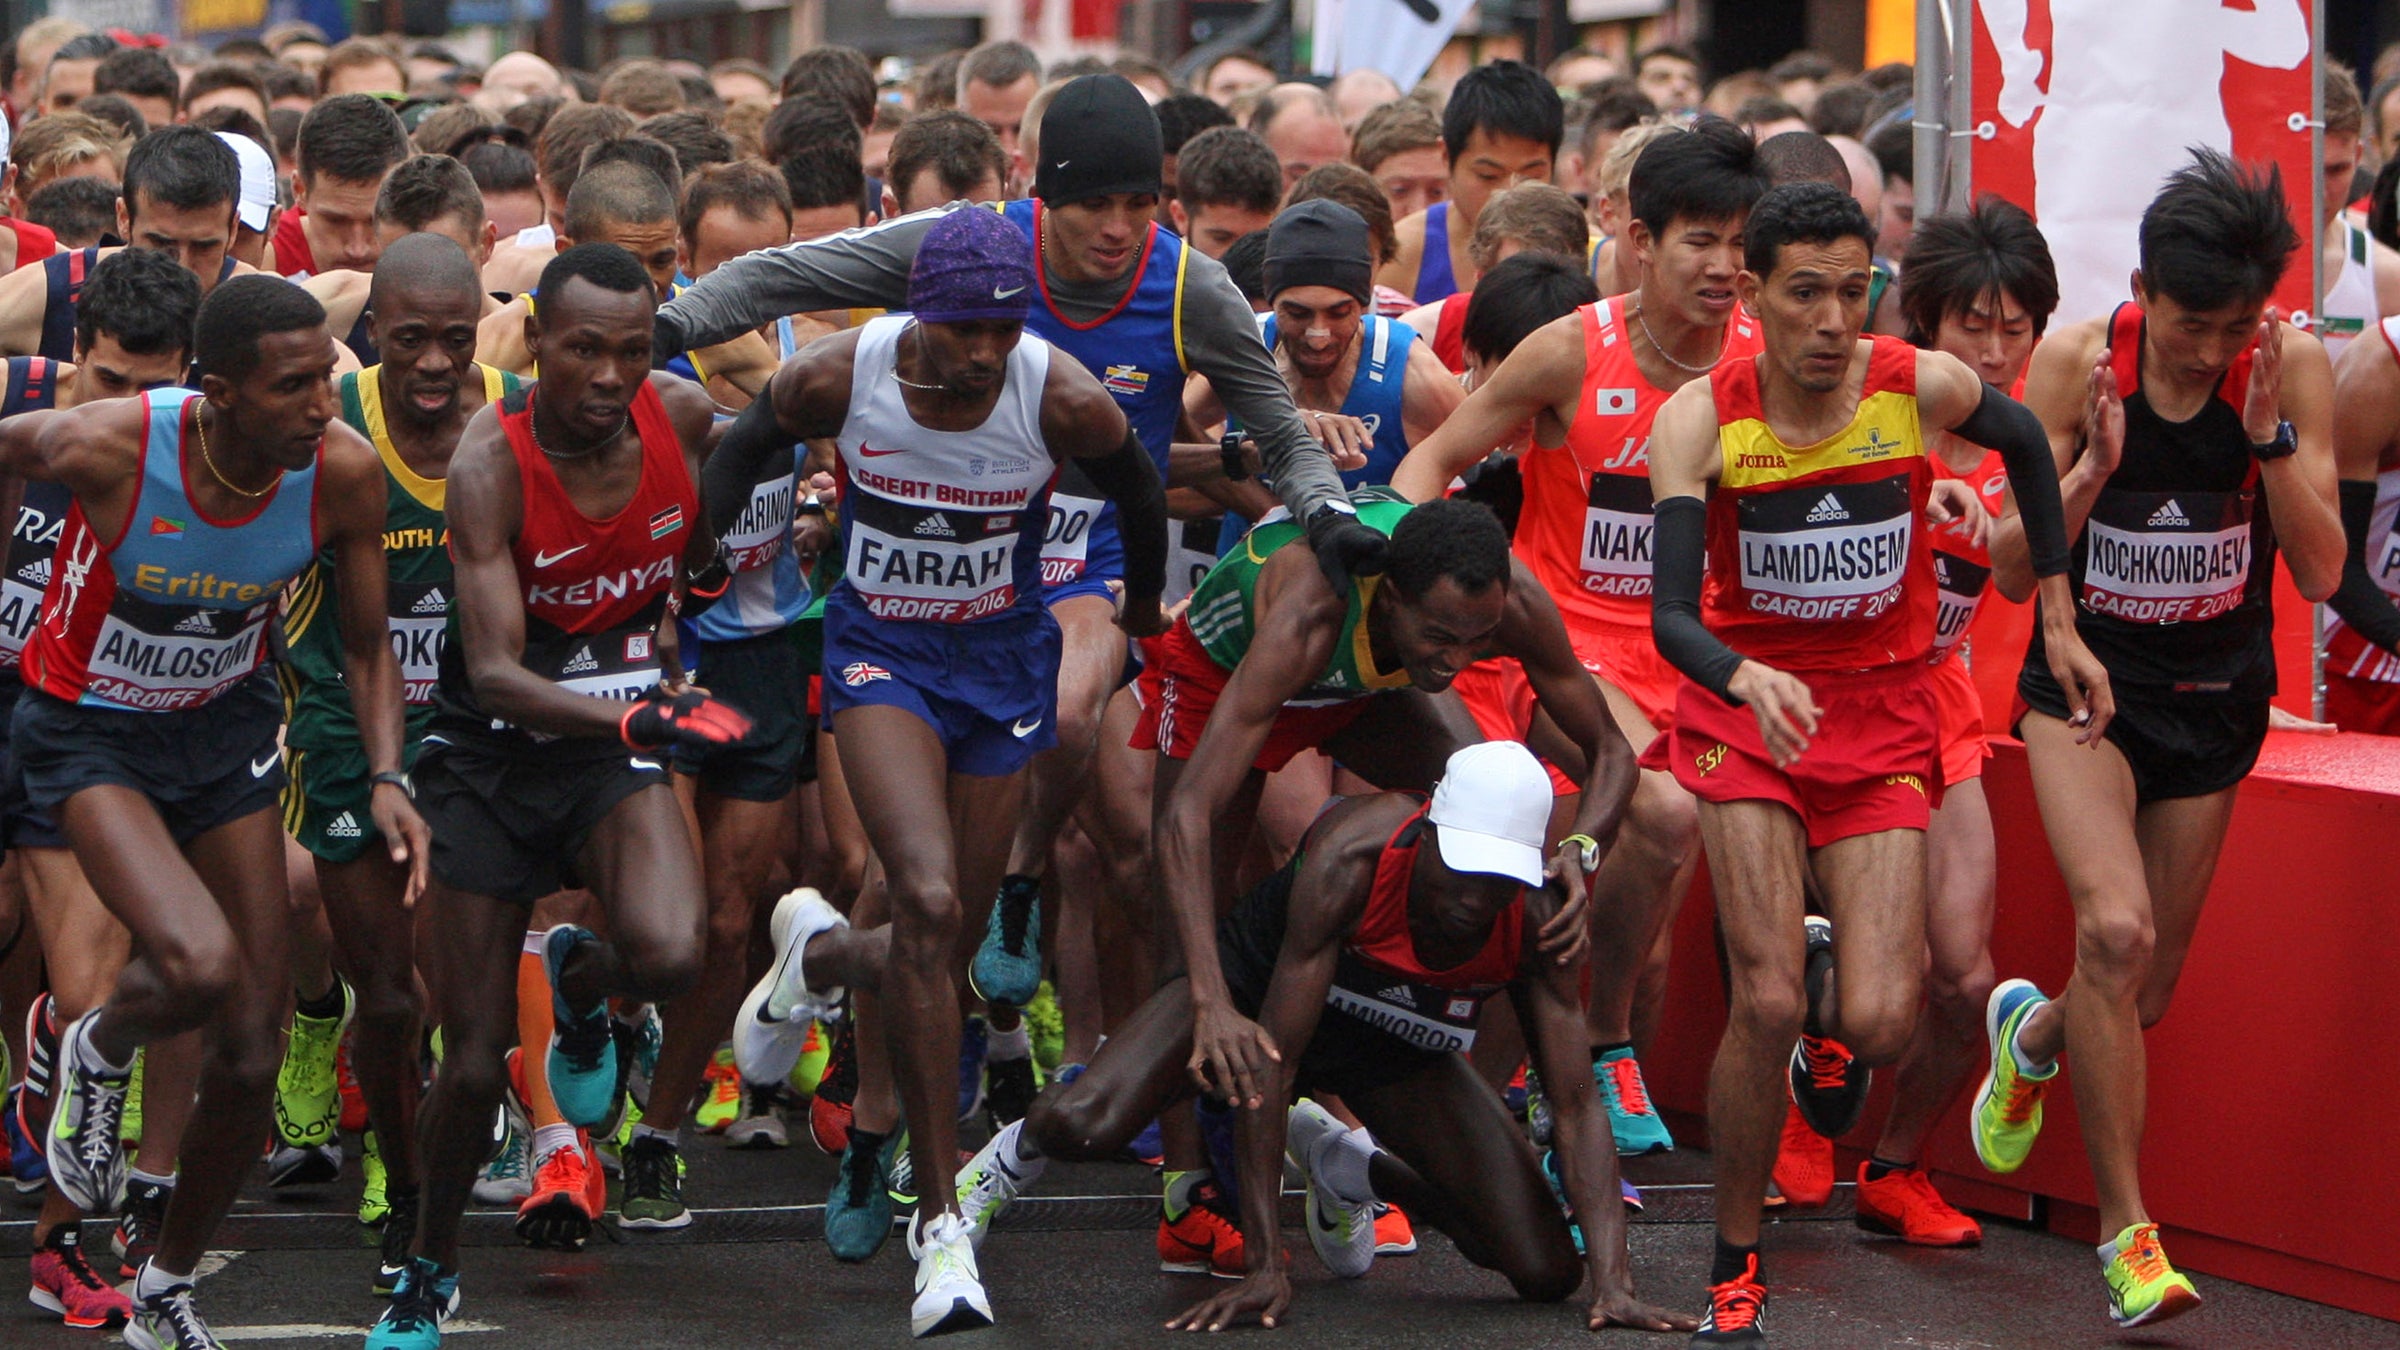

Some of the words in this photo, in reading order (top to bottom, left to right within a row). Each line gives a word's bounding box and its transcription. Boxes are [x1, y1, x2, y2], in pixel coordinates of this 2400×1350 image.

[858, 468, 931, 500] GREAT
[936, 483, 1028, 507] BRITAIN
[913, 525, 956, 537] adidas
[1805, 509, 1849, 523] adidas
[2147, 516, 2190, 527] adidas
[857, 537, 1006, 588] FARAH
[1745, 527, 1905, 585] LAMDASSEM
[2092, 532, 2247, 585] KOCHKONBAEV
[528, 554, 674, 605] KENYA
[962, 588, 1006, 620] 2016
[1751, 592, 1861, 619] CARDIFF
[2089, 591, 2196, 620] CARDIFF
[174, 623, 218, 635] adidas
[98, 629, 256, 680] AMLOSOM
[632, 638, 643, 657] 3
[562, 660, 599, 674] adidas
[90, 678, 202, 709] CARDIFF
[1695, 743, 1728, 778] ESP
[326, 825, 362, 838] adidas
[1377, 990, 1417, 1009] adidas
[274, 1092, 340, 1139] ROOK
